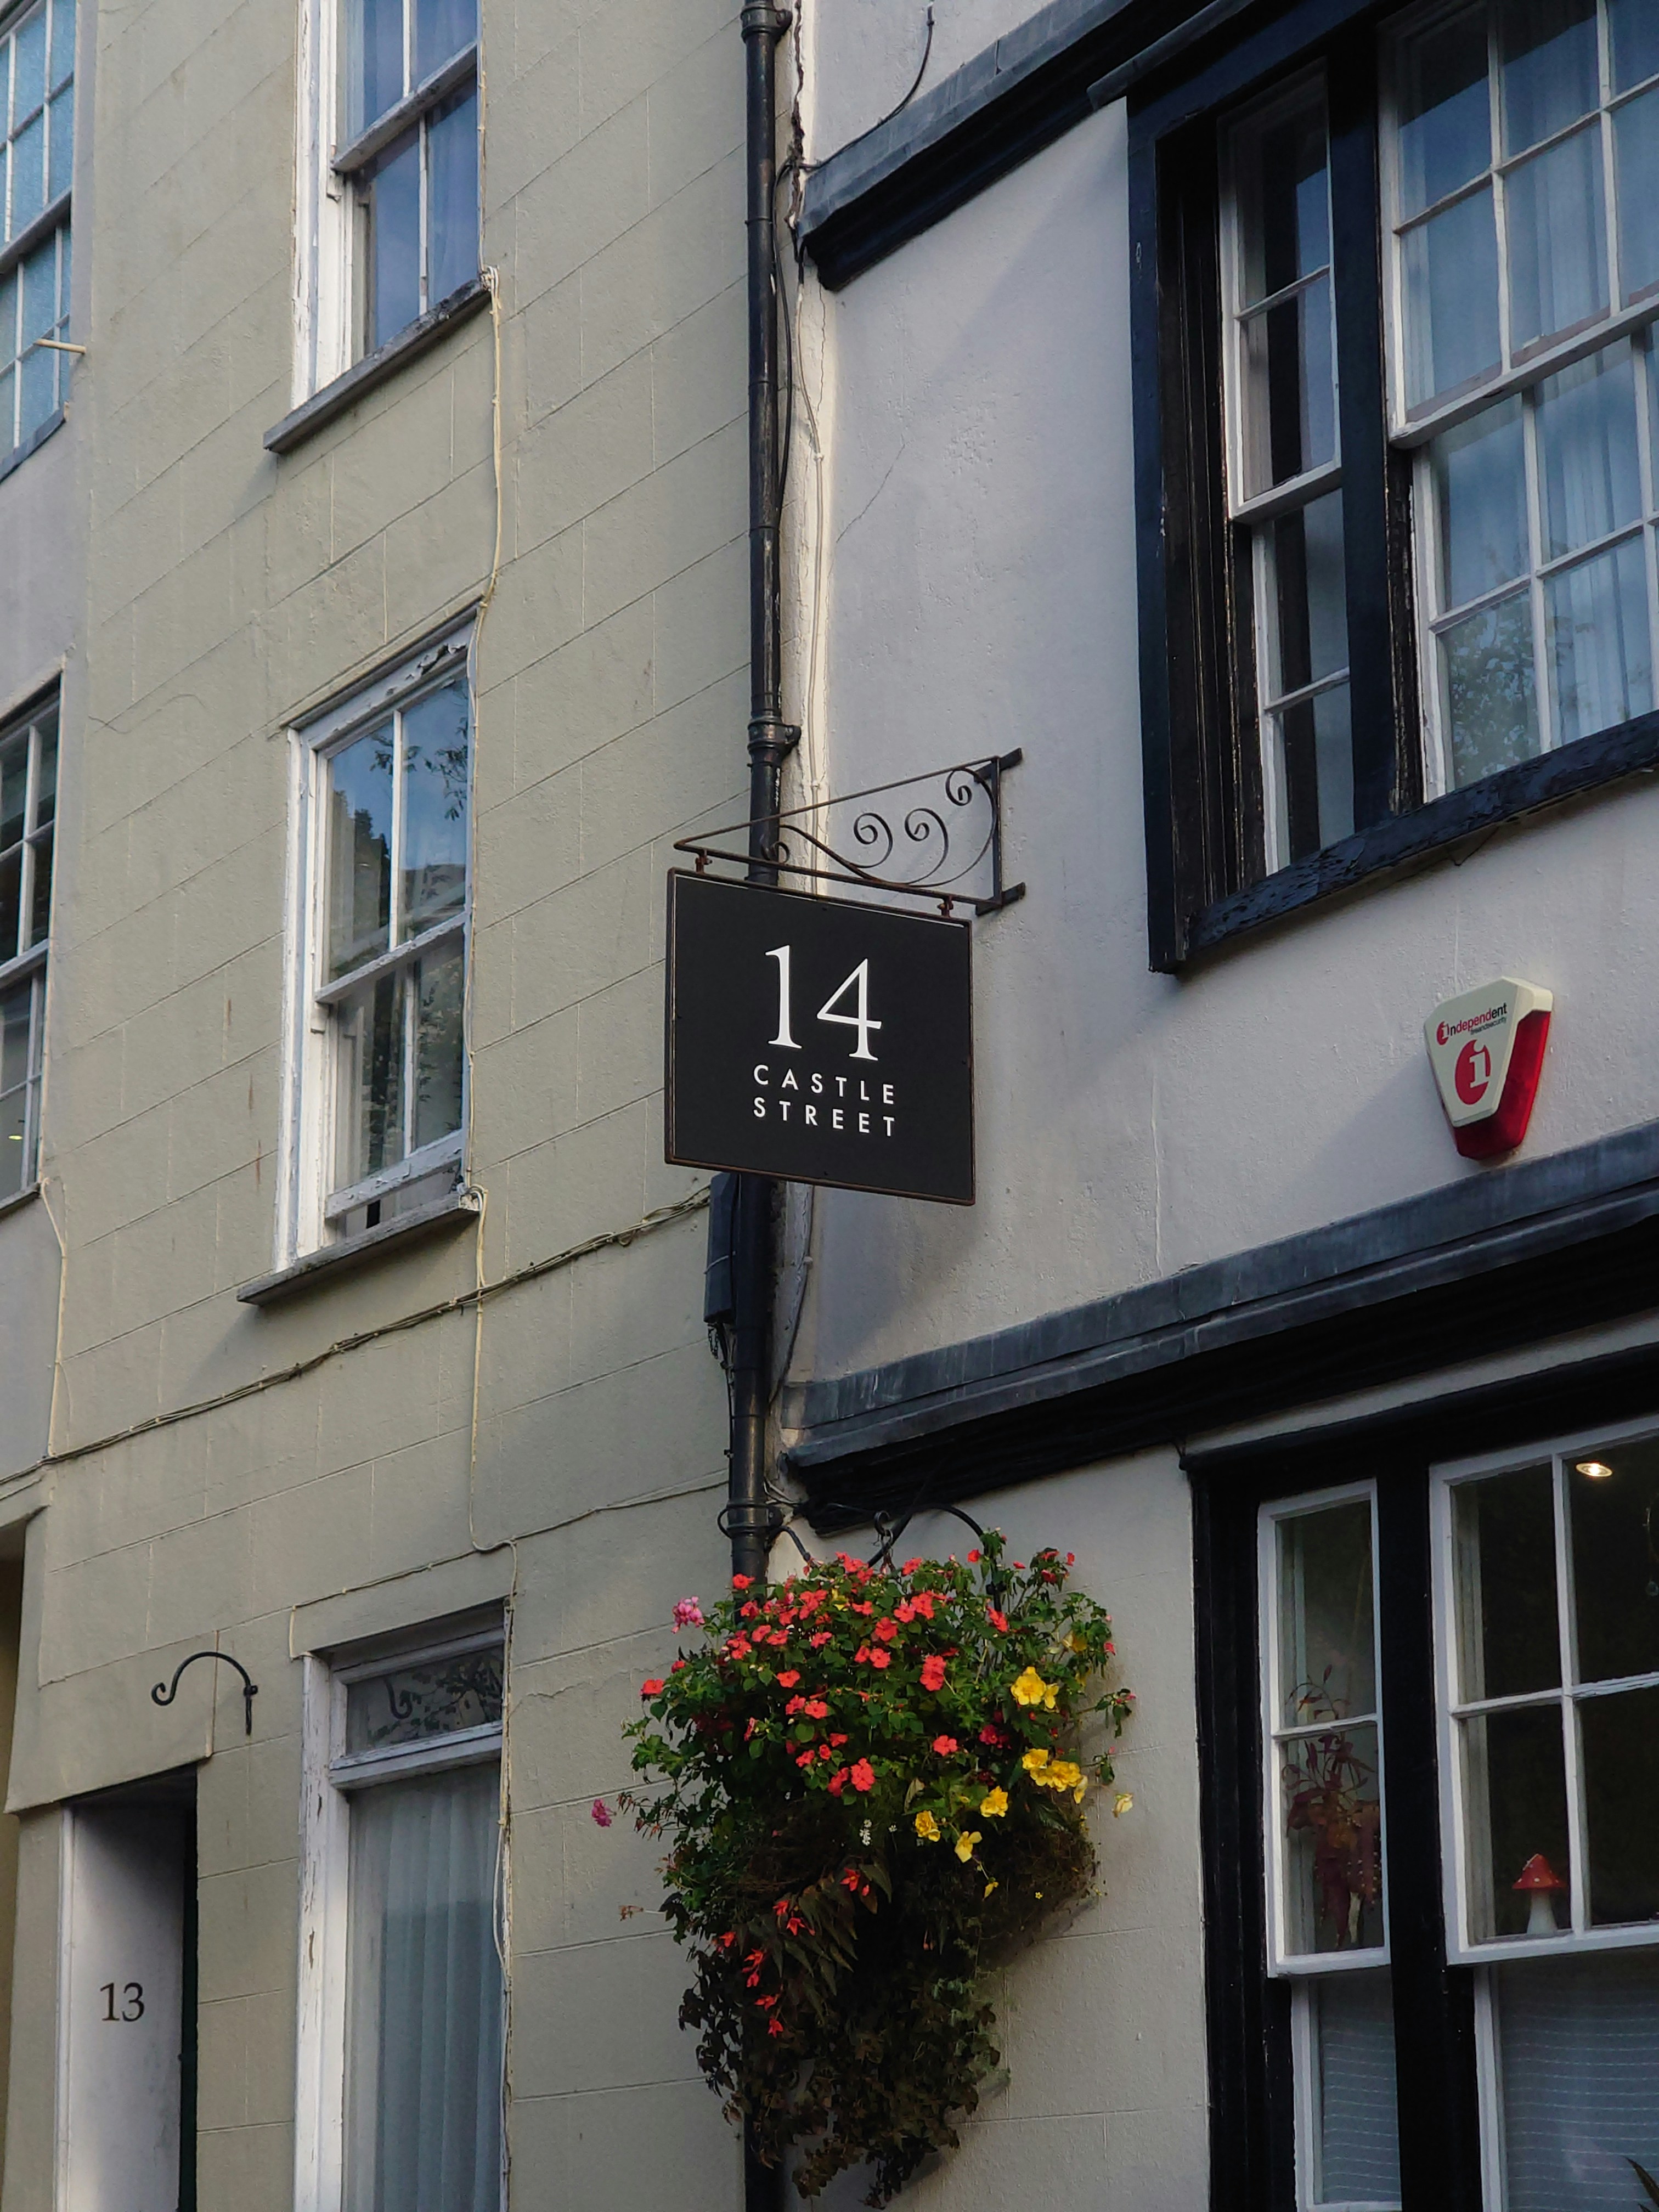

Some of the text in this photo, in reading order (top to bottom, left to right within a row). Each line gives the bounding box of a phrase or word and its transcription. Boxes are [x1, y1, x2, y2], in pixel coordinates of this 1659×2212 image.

[765, 945, 881, 1060] 14
[754, 1065, 894, 1104] CASTLE
[754, 1098, 895, 1137] STREET
[100, 1982, 144, 2022] 13
